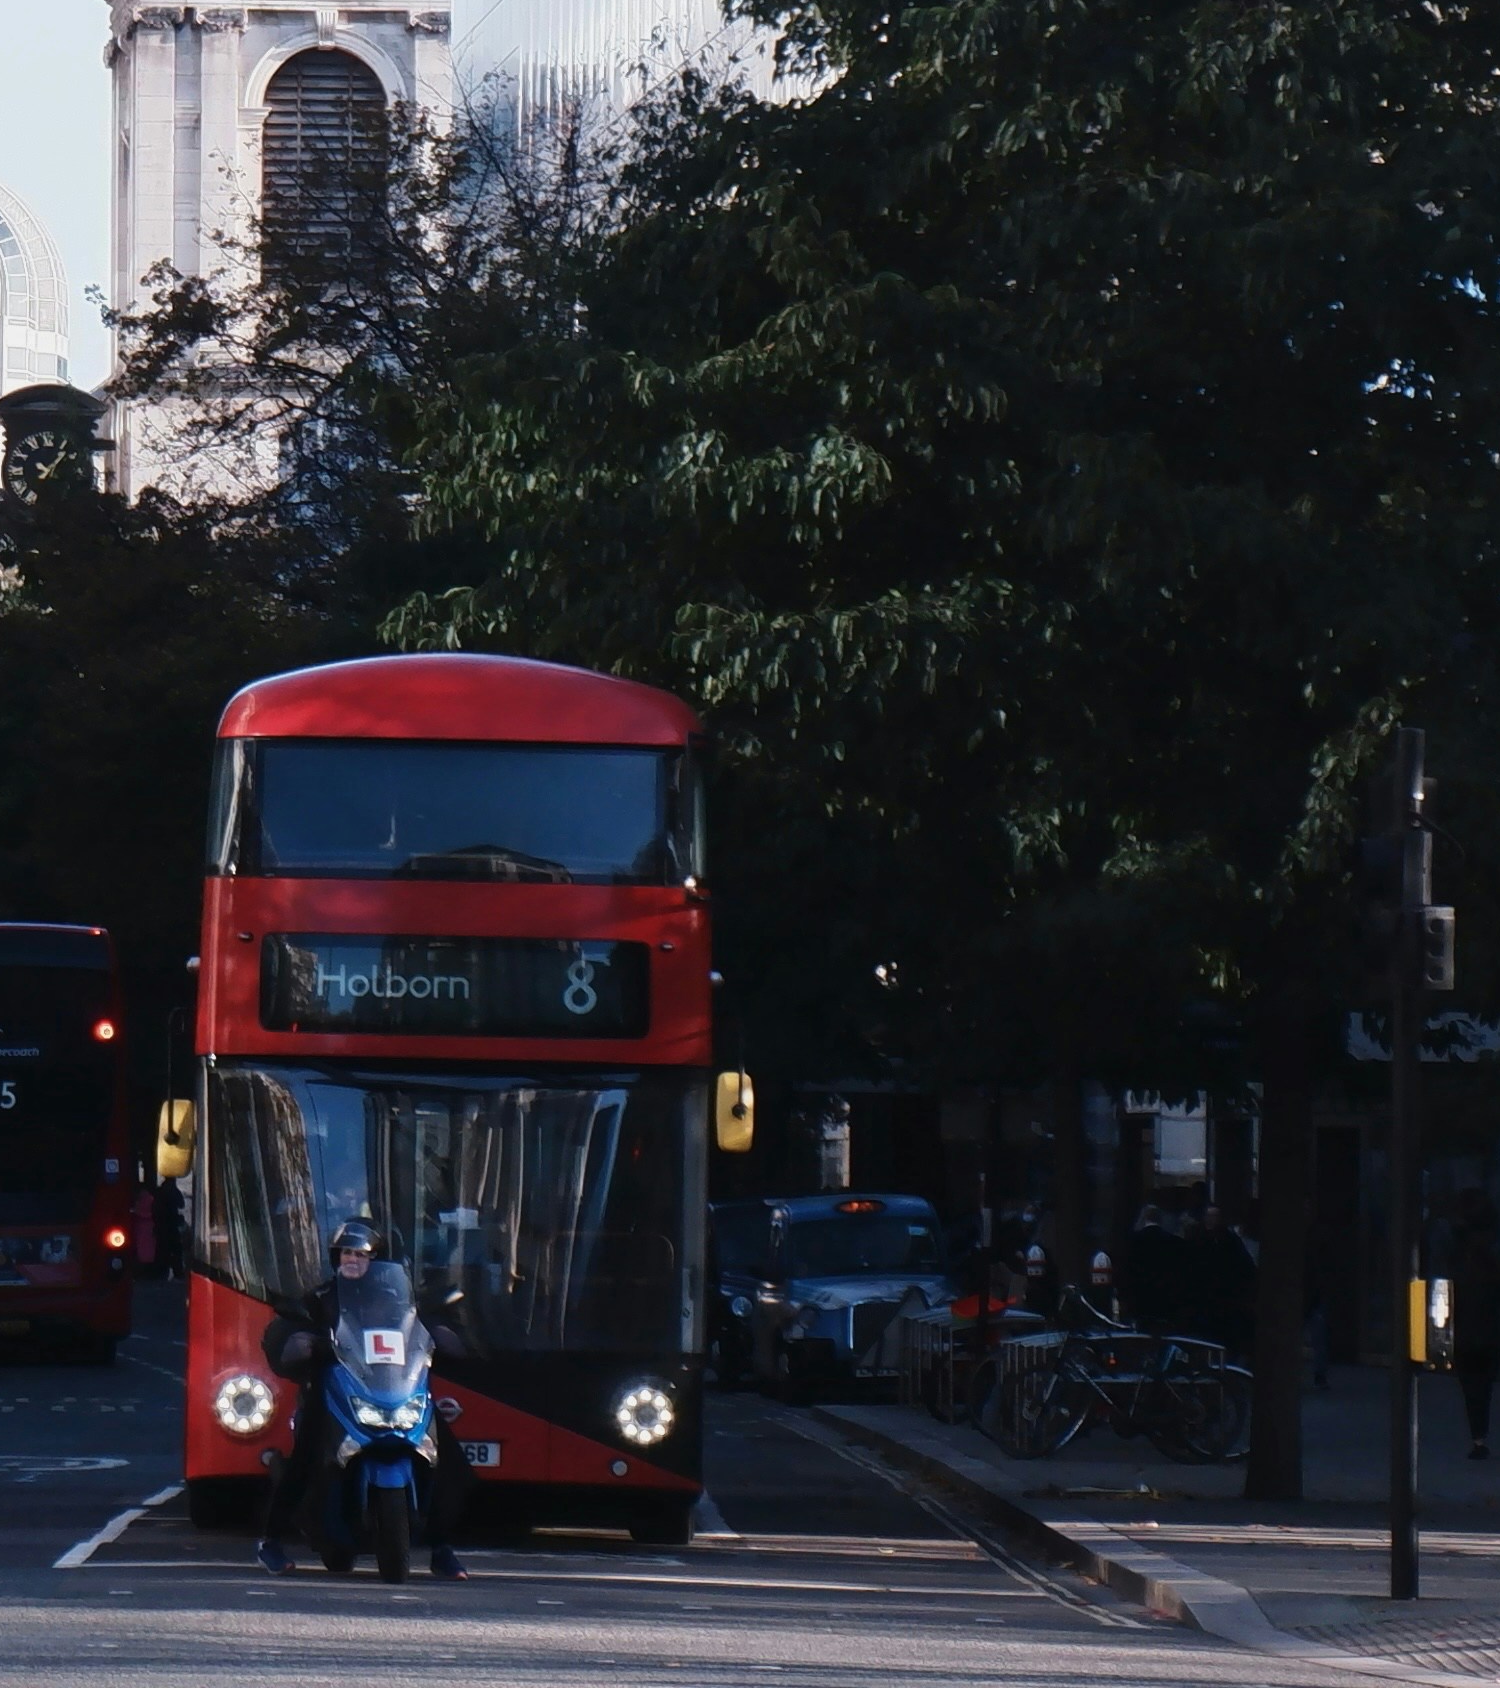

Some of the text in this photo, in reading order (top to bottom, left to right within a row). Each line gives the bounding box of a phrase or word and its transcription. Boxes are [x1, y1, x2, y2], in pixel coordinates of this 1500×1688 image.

[316, 963, 470, 1000] Holborn
[563, 960, 598, 1014] 8
[373, 1335, 396, 1355] L
